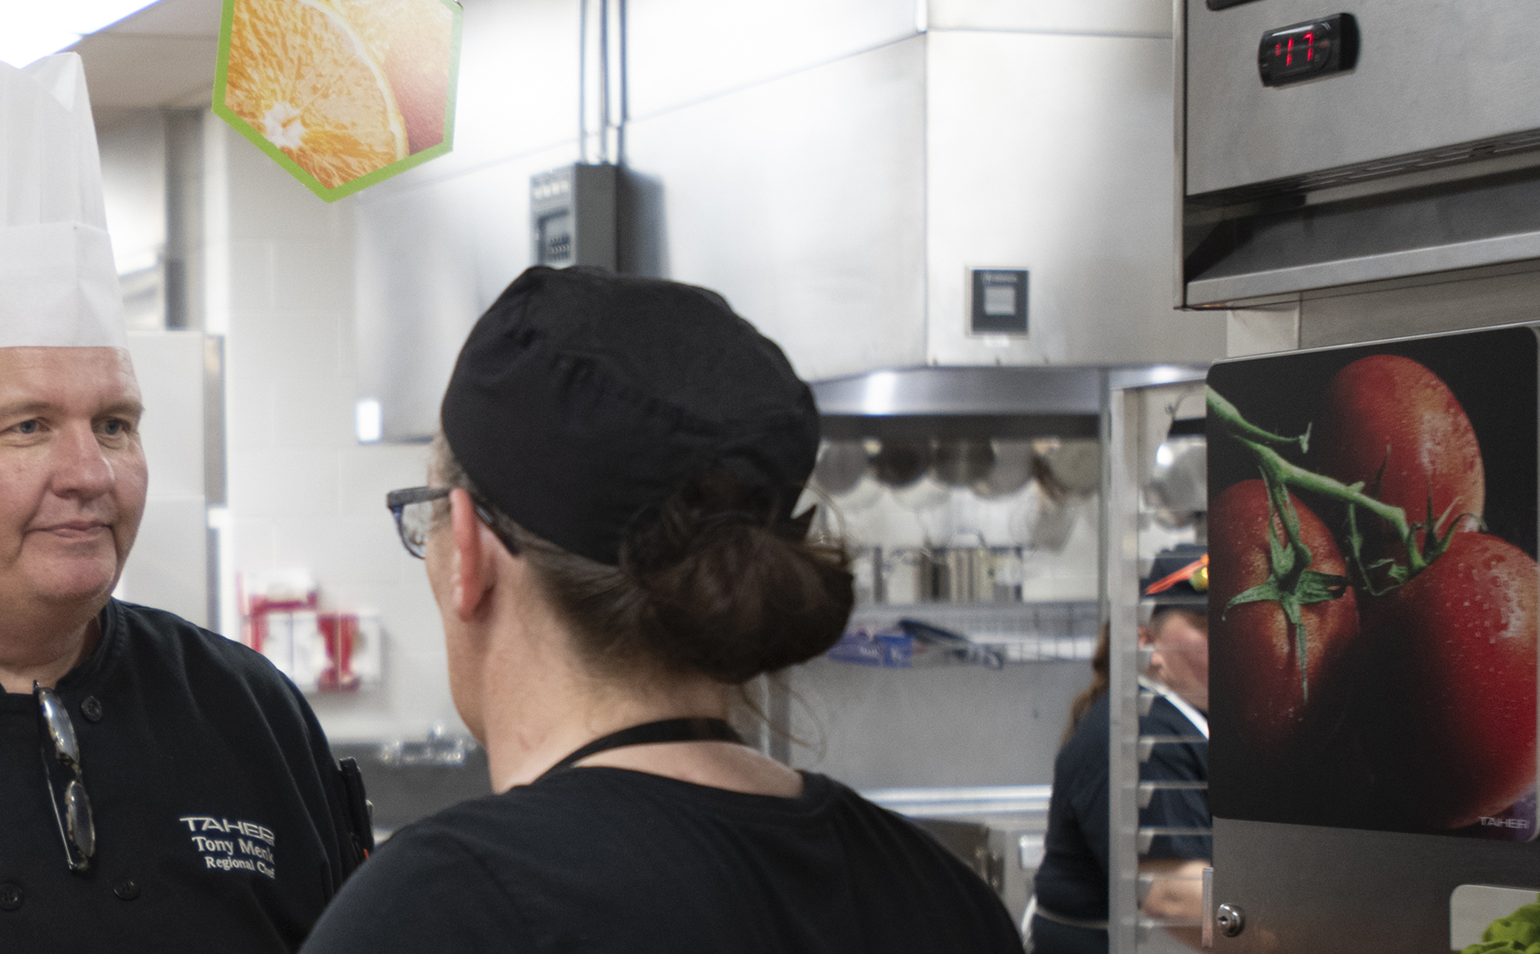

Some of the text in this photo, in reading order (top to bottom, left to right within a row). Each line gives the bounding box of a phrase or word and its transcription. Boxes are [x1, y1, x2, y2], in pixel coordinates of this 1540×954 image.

[1478, 816, 1530, 829] TAHER
[191, 835, 234, 856] Tony
[204, 855, 256, 872] Regional
